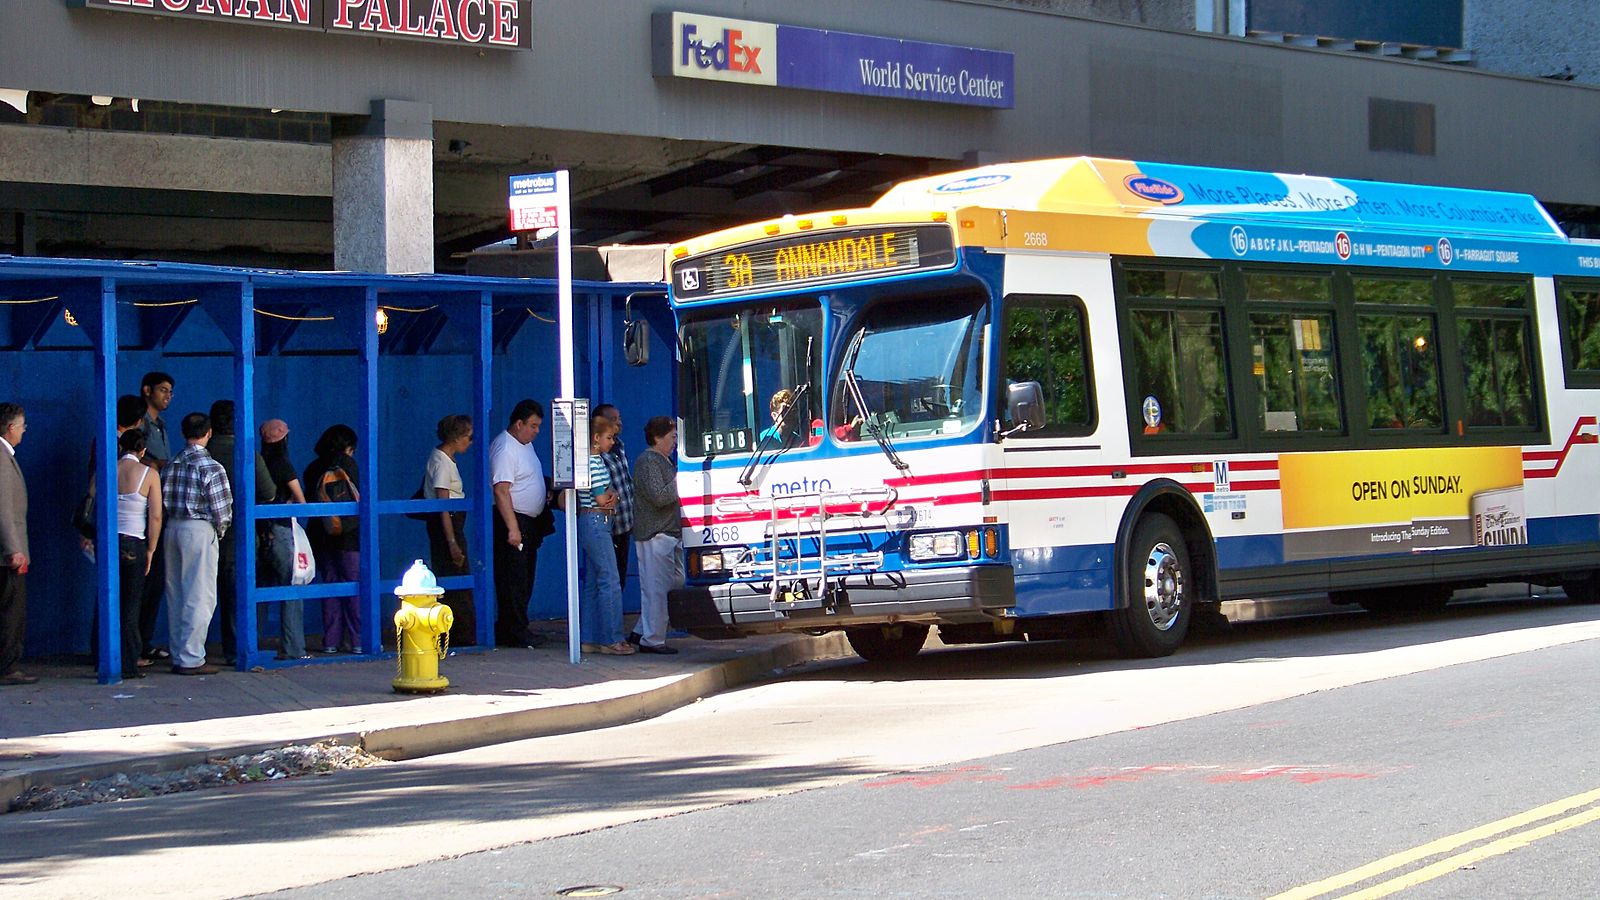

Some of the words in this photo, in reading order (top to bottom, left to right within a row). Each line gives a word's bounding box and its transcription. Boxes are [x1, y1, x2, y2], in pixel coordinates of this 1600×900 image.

[333, 0, 519, 46] PALACE
[682, 23, 762, 74] FedEx
[859, 58, 901, 88] World
[905, 63, 956, 95] Service
[959, 69, 1004, 99] Center
[513, 177, 555, 189] metrobus
[1188, 182, 1239, 204] More
[1237, 186, 1303, 208] Places.
[1299, 191, 1347, 212] More
[1398, 198, 1441, 219] More
[1437, 201, 1509, 224] Columbia
[1024, 231, 1048, 246] 2668
[1232, 232, 1246, 250] 16
[1337, 237, 1349, 255] 16
[1411, 245, 1425, 258] CITY
[724, 252, 752, 288] 3A
[776, 231, 898, 282] ANNANDALE
[1440, 243, 1451, 260] 16
[1495, 250, 1520, 263] SQUARE
[1577, 256, 1593, 268] THIS
[1215, 462, 1228, 484] M
[1352, 481, 1388, 501] OPEN
[1390, 479, 1411, 499] ON
[1412, 475, 1463, 495] SUNDAY.
[702, 525, 740, 545] 2668
[1371, 531, 1402, 543] Introducing
[1401, 530, 1412, 540] The
[1411, 526, 1430, 538] Sunday
[1430, 525, 1450, 535] Edition.
